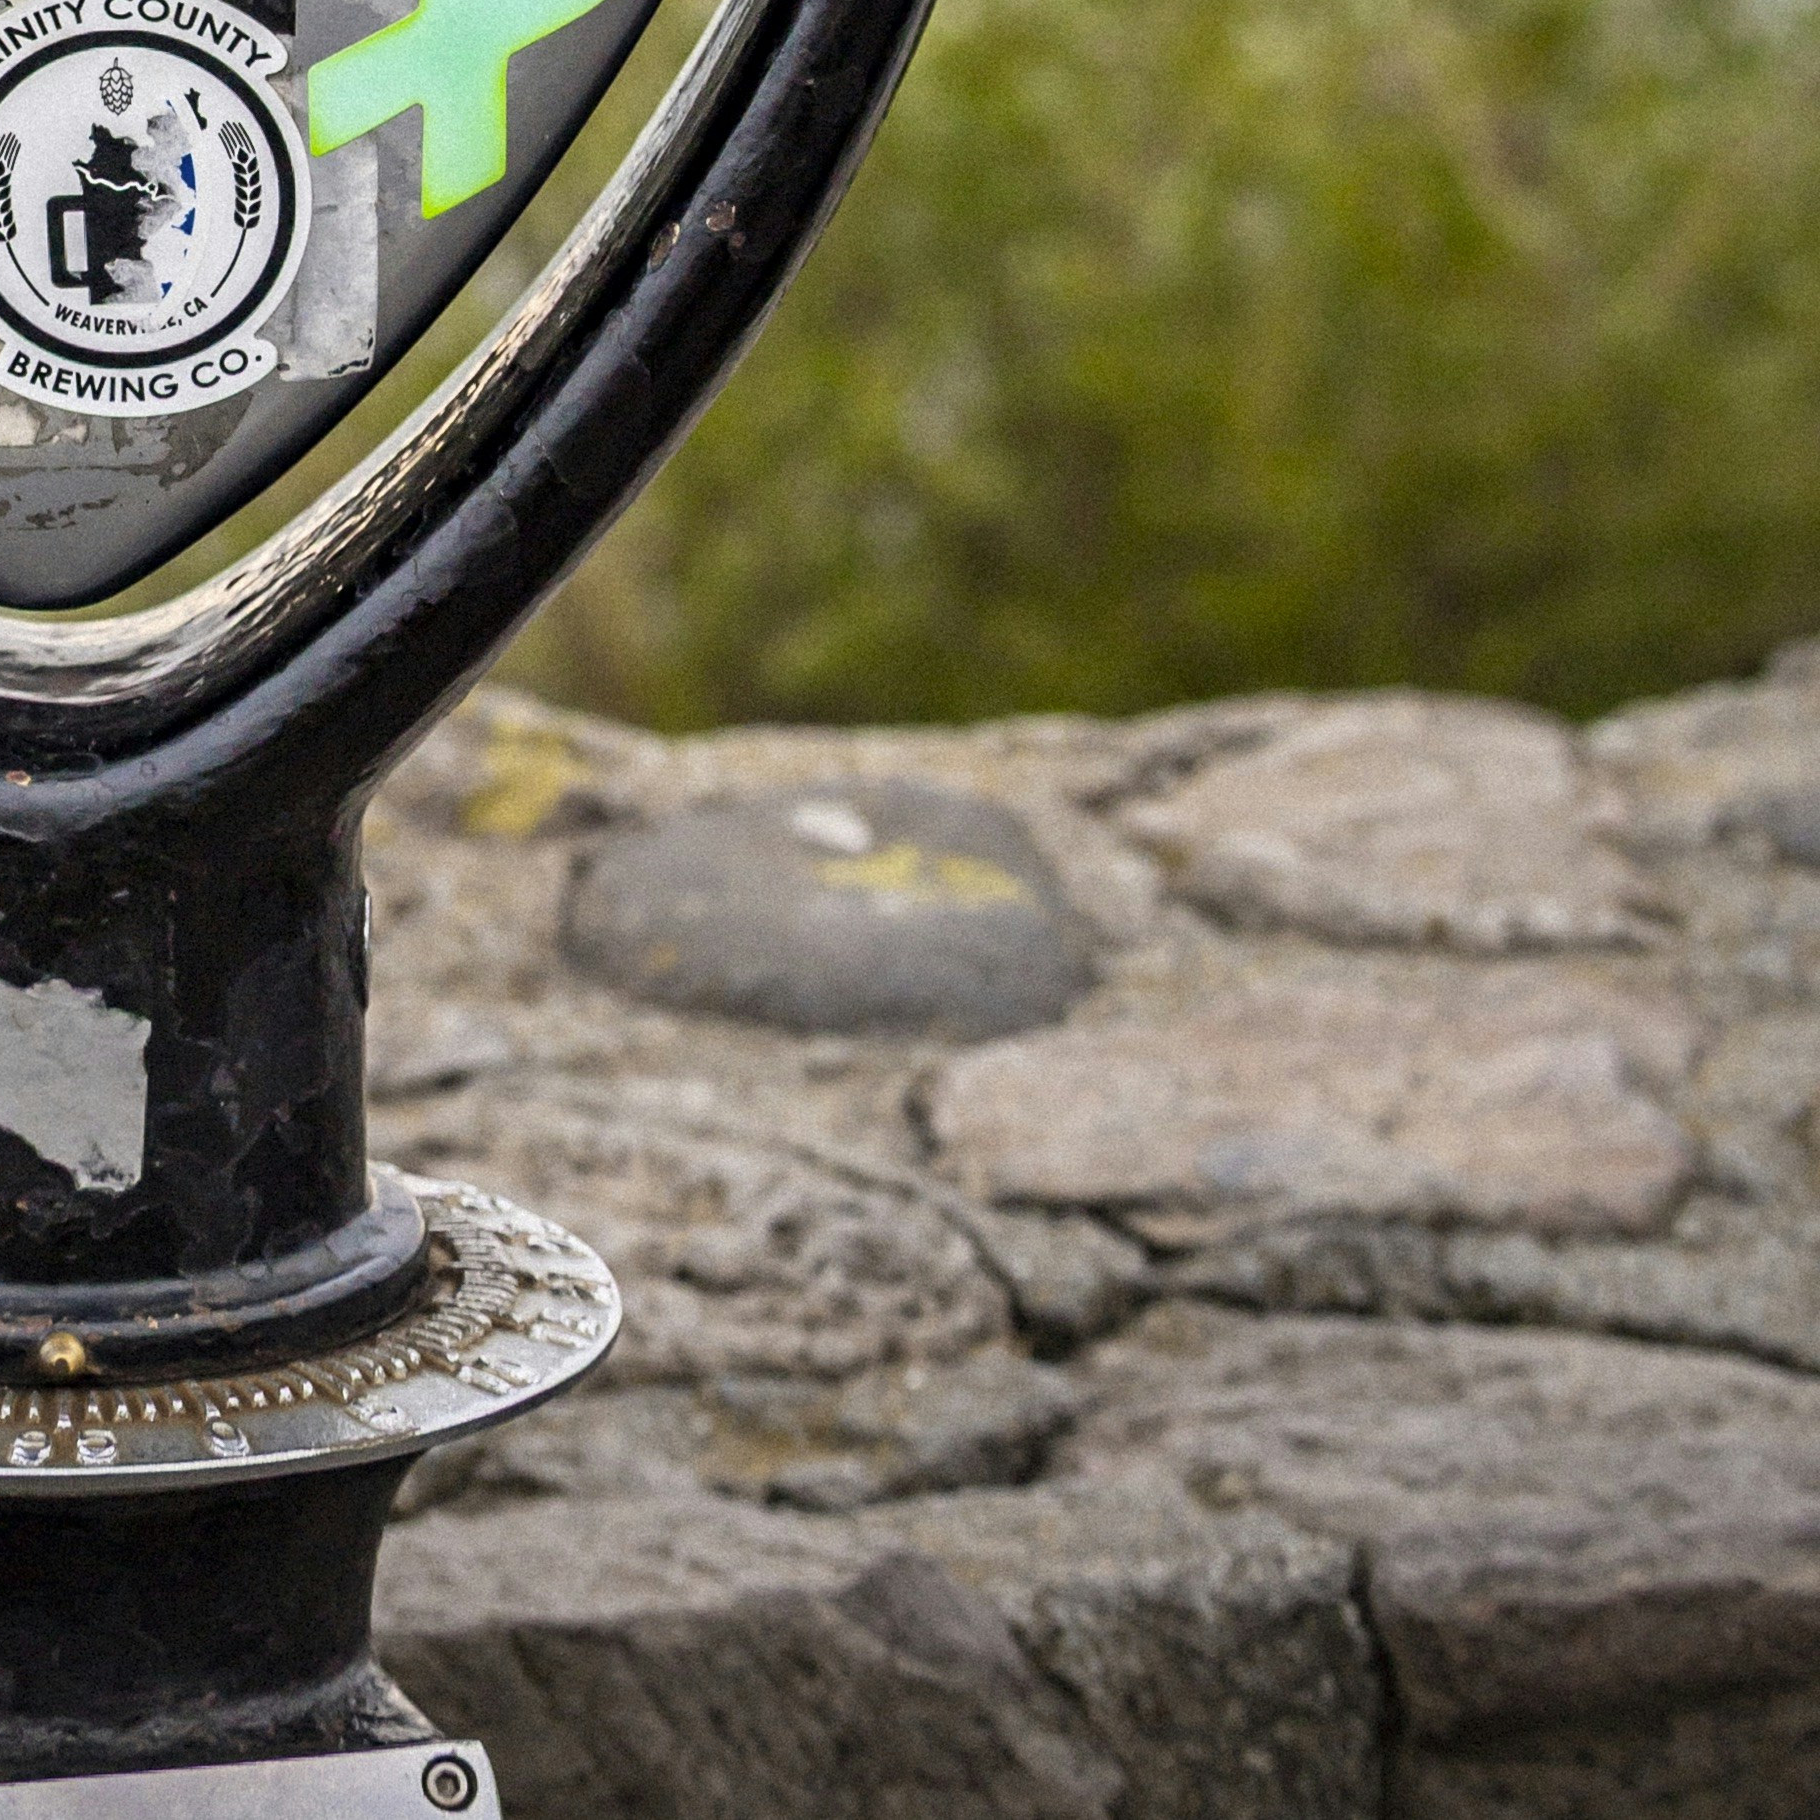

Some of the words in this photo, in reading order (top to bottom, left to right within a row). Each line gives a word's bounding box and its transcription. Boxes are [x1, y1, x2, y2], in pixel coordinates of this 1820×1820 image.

[183, 296, 208, 318] CA
[7, 351, 179, 402] BREWING
[190, 346, 264, 389] CO.
